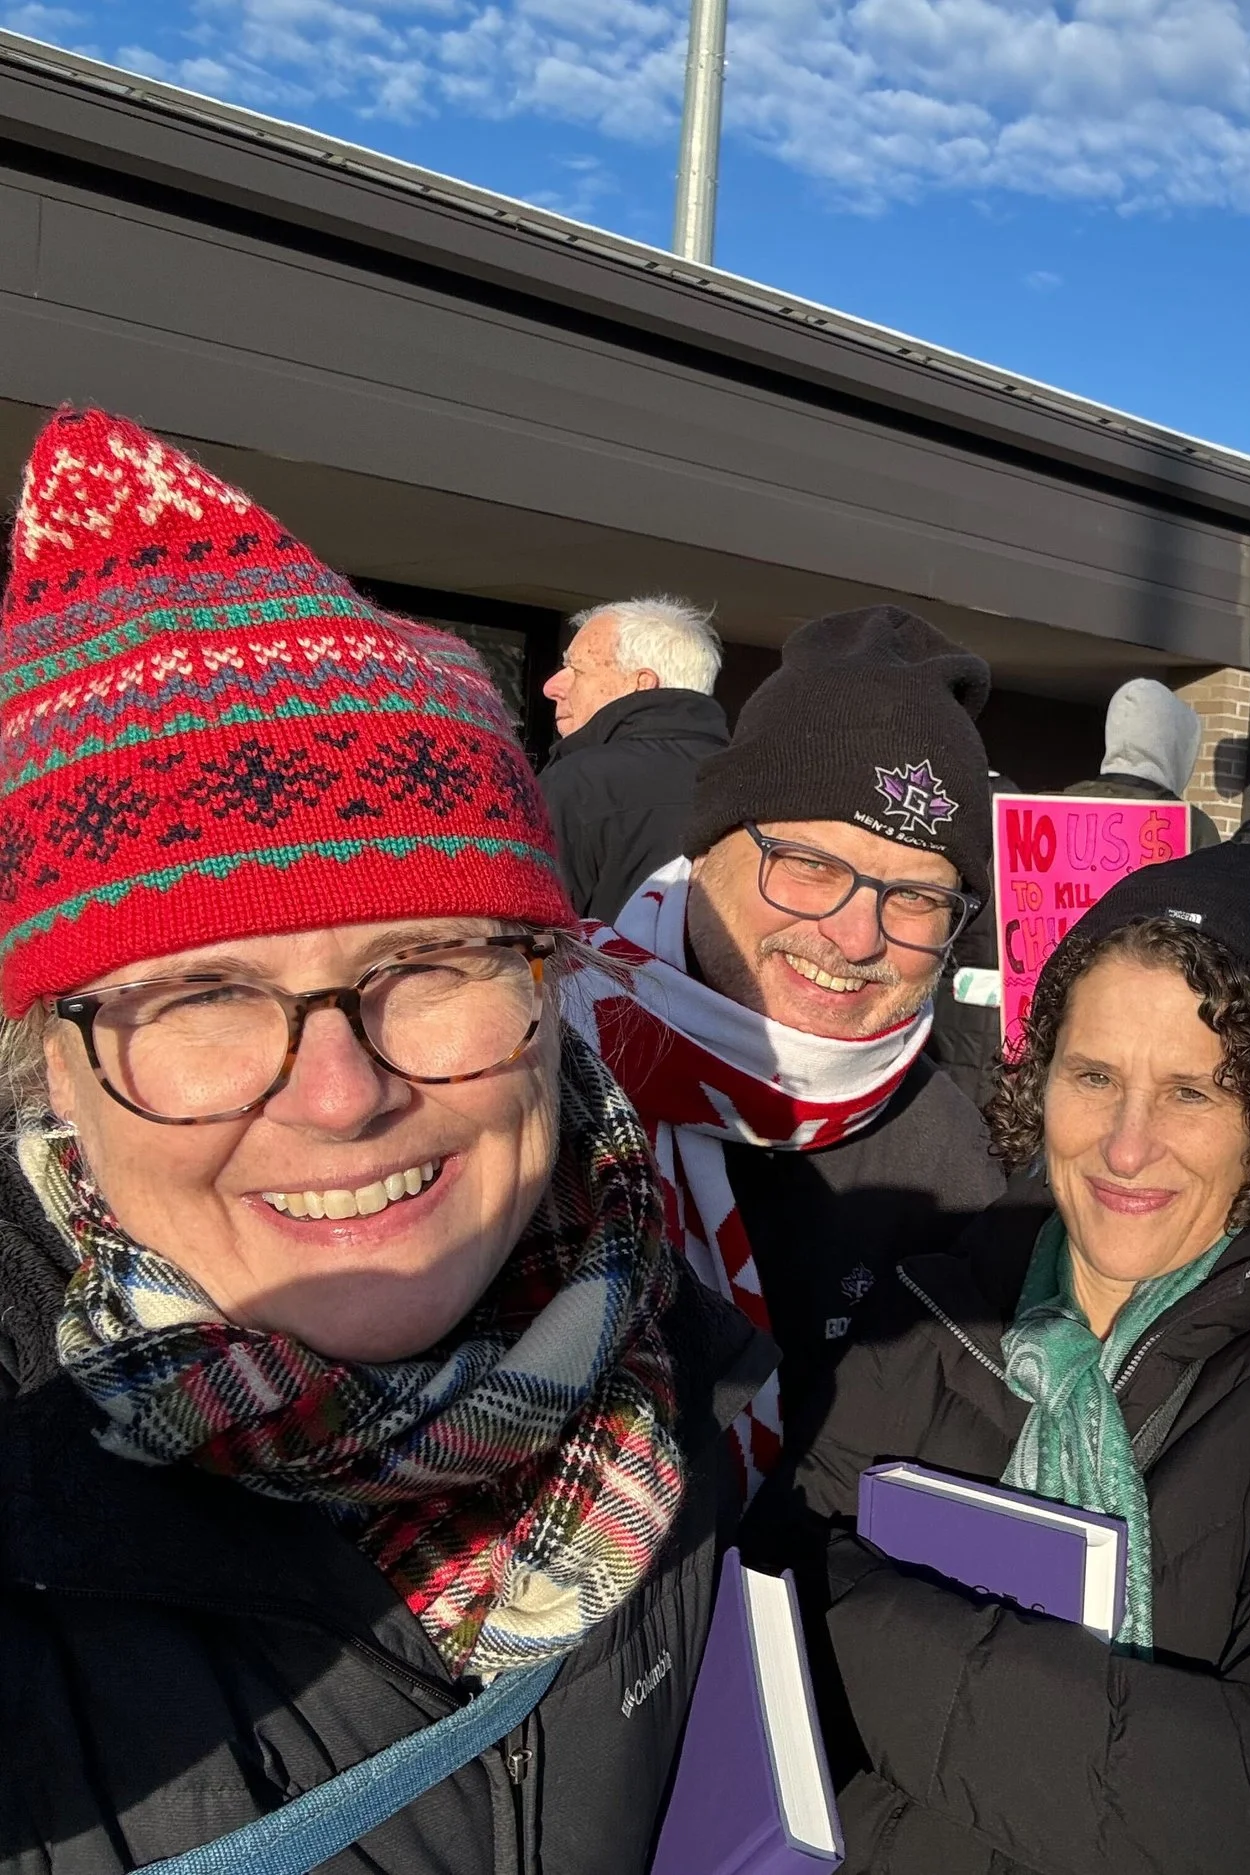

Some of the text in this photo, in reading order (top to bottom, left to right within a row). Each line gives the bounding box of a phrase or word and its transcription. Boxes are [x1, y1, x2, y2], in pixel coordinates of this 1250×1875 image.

[853, 810, 895, 836] MEN'S
[1005, 809, 1057, 873] NO
[1011, 880, 1098, 912] TO KILL
